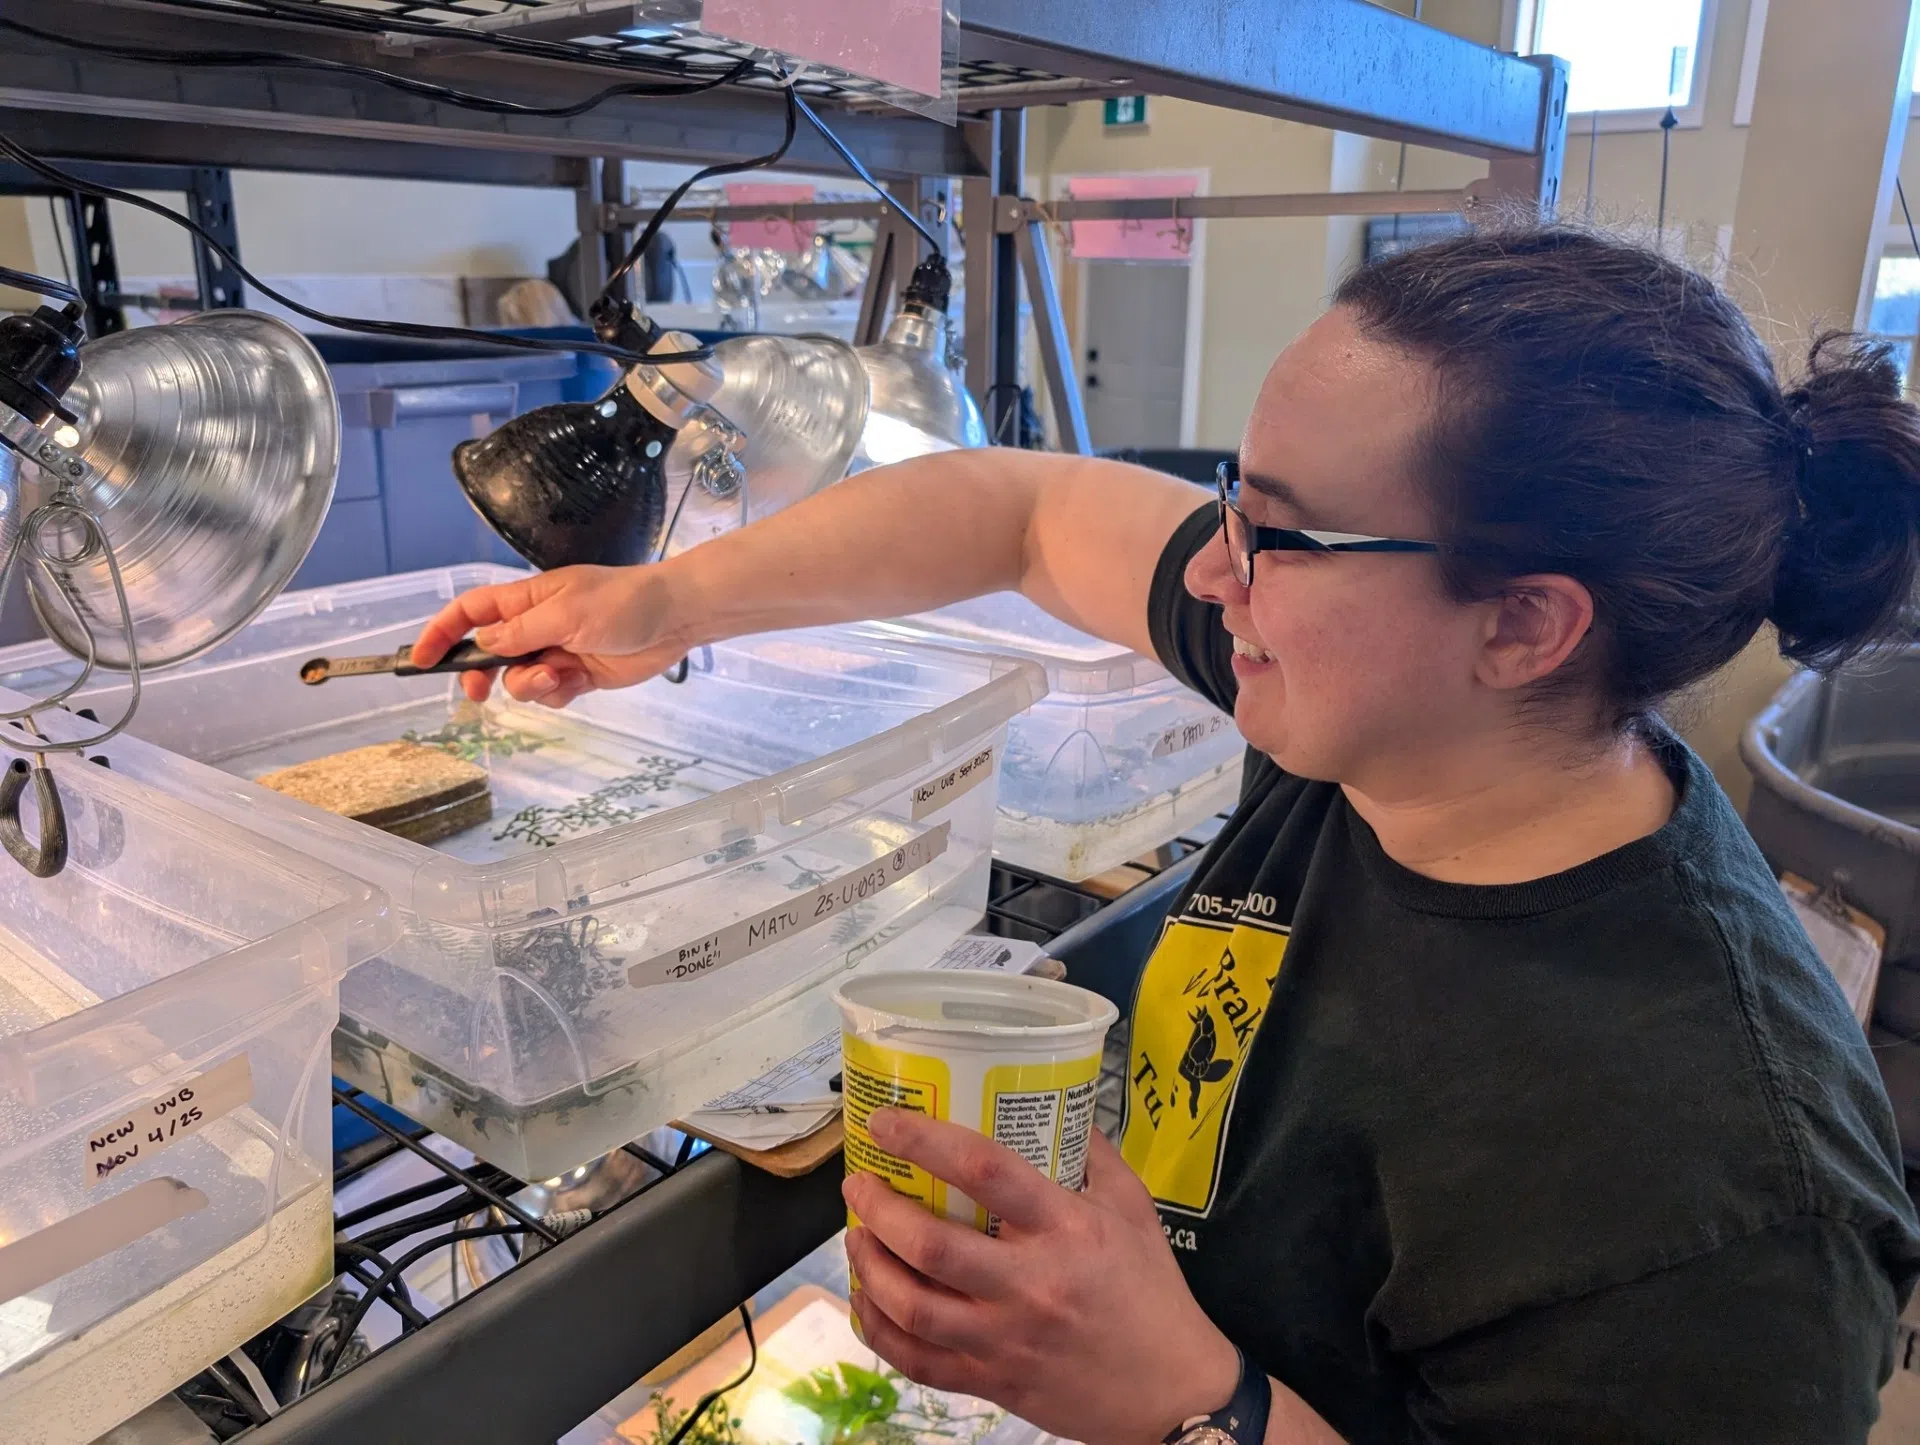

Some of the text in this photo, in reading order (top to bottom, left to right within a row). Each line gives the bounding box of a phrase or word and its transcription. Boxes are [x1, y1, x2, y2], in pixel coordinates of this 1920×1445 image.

[748, 911, 799, 947] MATU
[999, 1096, 1042, 1105] Ingredients:
[1016, 1121, 1037, 1129] Mono-
